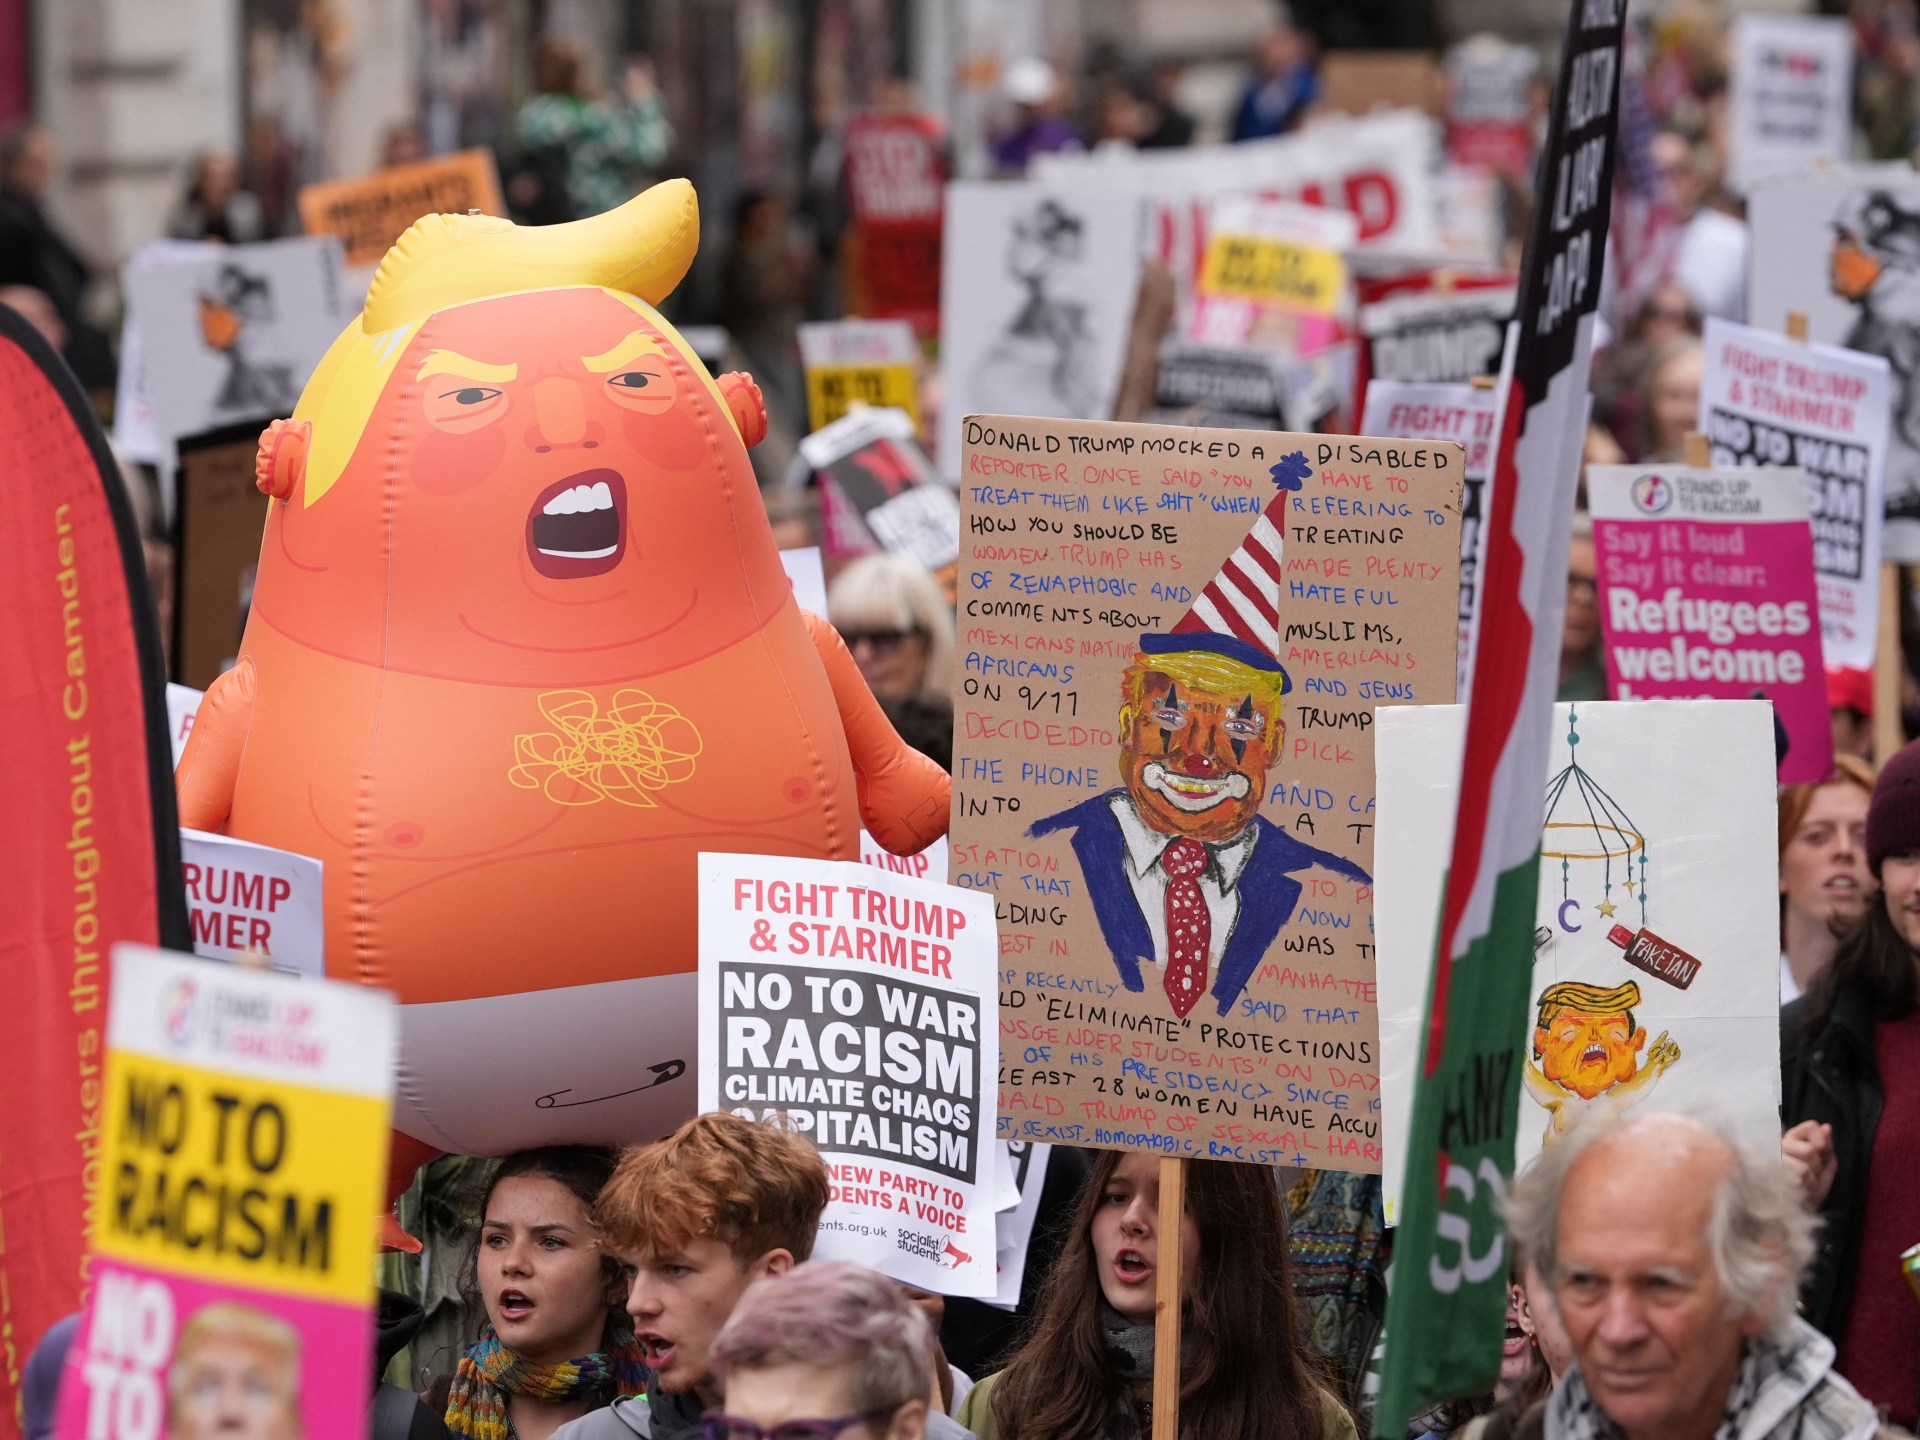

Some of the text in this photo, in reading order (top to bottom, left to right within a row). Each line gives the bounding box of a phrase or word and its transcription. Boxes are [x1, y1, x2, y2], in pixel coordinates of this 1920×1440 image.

[1720, 343, 1868, 402] FIGHT TRUMP
[1387, 403, 1464, 434] FIGHT
[1728, 379, 1856, 431] & STARMER
[967, 422, 1060, 454] DONALD
[1068, 436, 1135, 455] TRUMP
[1141, 437, 1240, 458] MOCKED
[1252, 446, 1264, 460] A
[1318, 443, 1448, 469] DISABLED
[1711, 409, 1869, 481] NO TO WAR
[971, 453, 1069, 484] REPORTER
[1083, 465, 1142, 487] ONCE
[1160, 467, 1202, 488] SAID
[1321, 470, 1374, 492] HAVE
[1386, 476, 1408, 494] TO
[1676, 477, 1751, 496] STAND UP
[970, 485, 1034, 506] TREAT
[1039, 492, 1090, 513] THEM
[1102, 495, 1149, 516] LIKE
[1293, 495, 1413, 517] REFERING
[1423, 509, 1445, 526] TO
[971, 514, 1404, 545] HOW YOU SHOULD BE TREATING
[1678, 497, 1762, 514] TO RACISM
[1059, 543, 1129, 571] TRUMP
[1139, 551, 1182, 570] HAS
[1287, 558, 1352, 578] MADE
[1366, 555, 1442, 582] PLENTY
[1603, 524, 1746, 558] Say it loud
[971, 571, 1399, 605] OF ZENAPHOBIC AND HATEFUL
[1606, 556, 1766, 588] Say it clear:
[54, 503, 90, 721] Camden
[966, 600, 1403, 645] COMMENTS ABOUT MUSLIMS,
[1607, 587, 1811, 645] Refugees
[967, 628, 1417, 669] MEXICANS NATIVE AMERICANS
[1613, 636, 1805, 684] welcome
[965, 652, 1414, 700] AFRICANS AND JEWS
[964, 678, 1373, 732] ON 9/11 TRUMP
[1293, 738, 1355, 764] PICK
[960, 757, 1004, 784] THE
[1022, 762, 1099, 788] PHONE
[1270, 783, 1335, 810] AND
[960, 792, 1315, 836] INTO A
[66, 733, 101, 1014] throughout
[182, 862, 292, 914] RUMP
[954, 844, 1059, 874] STATION
[1310, 879, 1337, 898] TO
[734, 878, 967, 941] FIGHT TRUMP
[957, 872, 1003, 892] OUT
[1020, 875, 1071, 898] THAT
[1299, 907, 1351, 929] NOW
[749, 918, 778, 954] &
[788, 921, 953, 980] STARMER
[1050, 938, 1069, 957] IN
[1284, 936, 1336, 956] WAS
[1631, 937, 1697, 984] FAKE TAN
[723, 971, 793, 1011] NO
[805, 975, 864, 1017] TO
[876, 983, 977, 1042] WAR
[1026, 971, 1120, 999] RECENTLY
[1241, 998, 1287, 1023] SAID
[1302, 1006, 1360, 1025] THAT
[1037, 993, 1191, 1043] "ELIMINATE"
[1200, 1023, 1372, 1064] PROTECTIONS
[726, 1015, 974, 1099] RACISM
[1024, 1046, 1051, 1063] OF
[1070, 1052, 1104, 1067] HIS
[1122, 1057, 1272, 1101] PRESIDENCY
[1287, 1083, 1350, 1111] SINCE
[1131, 1039, 1268, 1075] STUDENTS"
[1275, 1062, 1312, 1083] ON
[1328, 1067, 1380, 1091] DAY
[124, 1070, 287, 1174] NO TO
[725, 1074, 865, 1108] CLIMATE
[872, 1084, 972, 1132] CHAOS
[1080, 1101, 1157, 1130] TRUMP
[1166, 1115, 1199, 1133] OF
[1212, 1124, 1320, 1150] SEXUAL
[1092, 1077, 1124, 1096] 28
[1136, 1086, 1237, 1117] WOMEN
[1254, 1103, 1316, 1130] HAVE
[73, 1026, 101, 1248] workers
[1208, 1141, 1285, 1164] RACIST
[827, 1163, 964, 1211] NEW PARTY TO
[111, 1160, 334, 1273] RACISM
[897, 1196, 911, 1215] A
[915, 1200, 968, 1234] VOICE
[898, 1228, 940, 1251] socialist
[897, 1240, 941, 1263] students
[90, 1270, 176, 1369] NO
